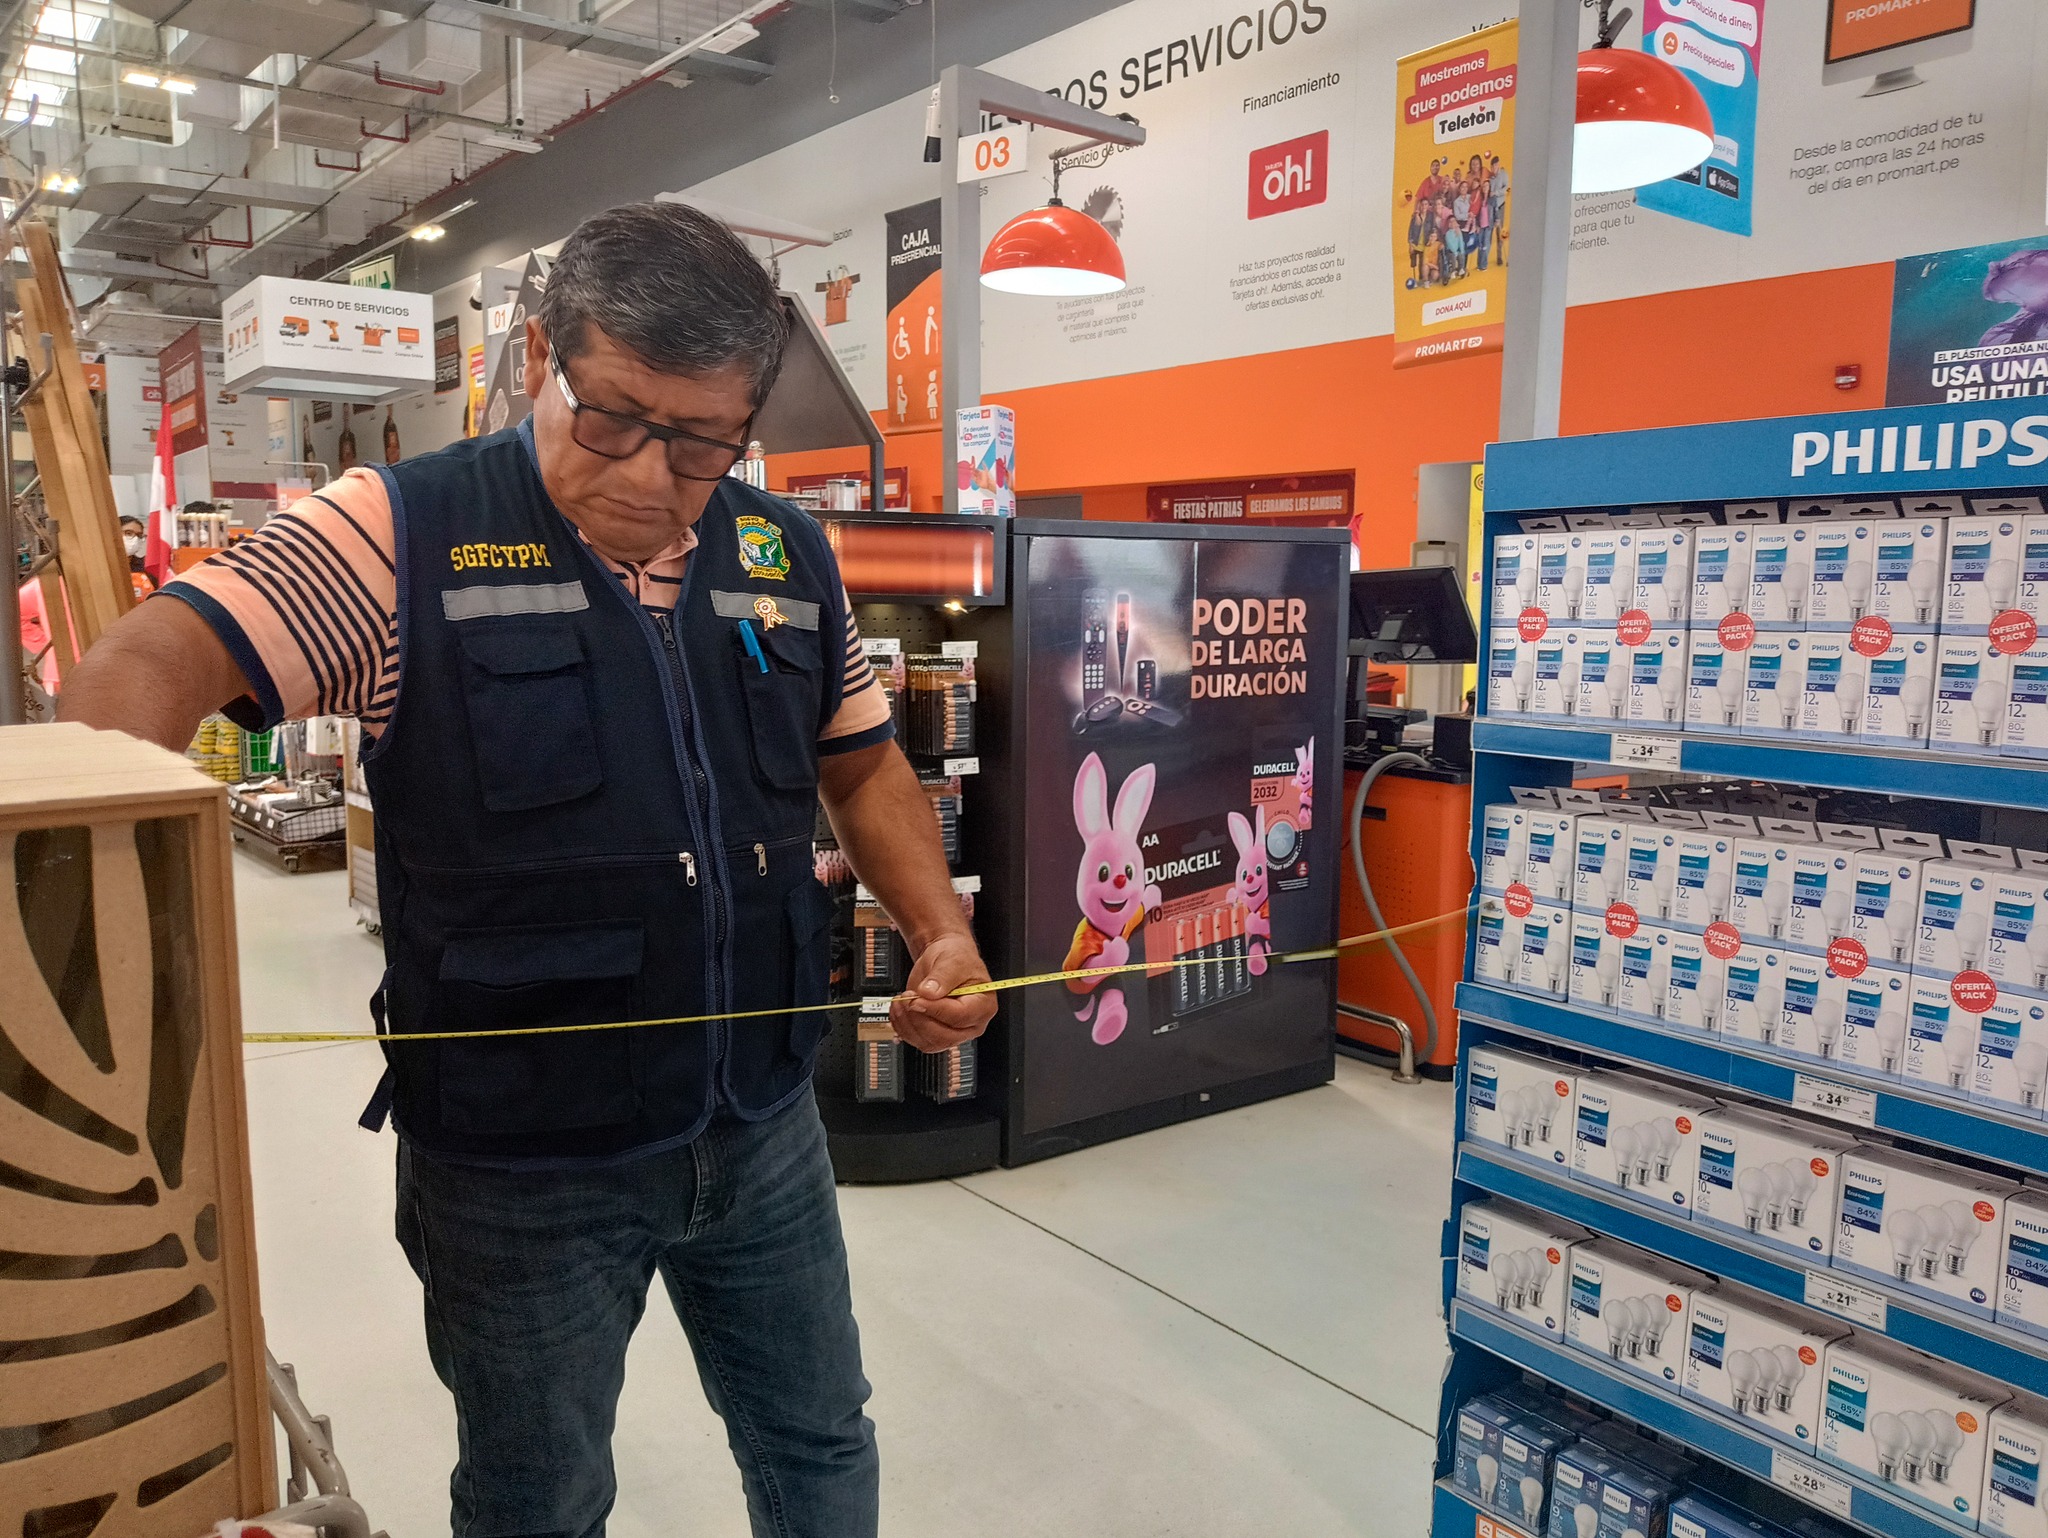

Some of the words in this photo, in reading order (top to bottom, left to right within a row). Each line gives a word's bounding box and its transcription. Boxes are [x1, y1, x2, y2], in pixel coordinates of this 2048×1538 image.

[1718, 13, 1728, 23] de
[1729, 16, 1753, 31] dinero
[1119, 0, 1328, 99] SERVICIOS
[1683, 41, 1703, 60] Precios
[1703, 53, 1735, 71] especiales
[1420, 57, 1485, 87] Mostremos
[1243, 72, 1340, 113] Financiamiento
[1410, 97, 1437, 118] que
[1440, 74, 1513, 111] podemos
[1793, 142, 1837, 161] Desde
[1840, 139, 1852, 152] la
[1855, 120, 1938, 149] comodidad
[1943, 115, 1963, 131] de
[1968, 112, 1983, 125] tu
[975, 136, 1010, 171] 03
[1061, 149, 1099, 171] Servicio
[1790, 163, 1830, 181] hogar,
[1834, 150, 1888, 172] compra
[1893, 146, 1913, 161] las
[1917, 140, 1936, 156] 24
[1942, 131, 1984, 150] horas
[1263, 149, 1312, 201] oh!
[1265, 162, 1283, 172] TARJETA
[1808, 180, 1828, 195] del
[1831, 176, 1852, 191] día
[1856, 175, 1873, 187] en
[1877, 156, 1960, 183] promart.pe
[1574, 200, 1630, 218] ofrecemos
[1574, 222, 1597, 236] para
[1600, 218, 1621, 231] que
[1624, 214, 1635, 225] tu
[902, 228, 929, 250] CAJA
[891, 244, 943, 267] PREFERENCIAL
[1239, 263, 1252, 273] Haz
[1254, 261, 1265, 270] tus
[1267, 252, 1303, 269] proyectos
[1305, 244, 1336, 259] realidad
[1281, 269, 1291, 278] en
[1292, 263, 1318, 276] cuotas
[1320, 260, 1335, 270] con
[1337, 258, 1345, 266] tu
[1232, 289, 1254, 301] Tarjeta
[1271, 280, 1304, 293] Además,
[1306, 273, 1334, 287] accede
[289, 295, 334, 309] CENTRO
[337, 300, 351, 311] DE
[354, 302, 409, 317] SERVICIOS
[1245, 299, 1270, 311] ofertas
[1271, 293, 1308, 308] exclusivas
[1435, 304, 1454, 316] DONA
[1454, 298, 1472, 312] AQUÍ
[494, 309, 506, 328] 01
[1415, 339, 1468, 358] PROMART
[1937, 352, 1949, 362] EL
[1950, 346, 2001, 360] PLÁSTICO
[2002, 342, 2034, 356] DAÑA
[89, 373, 101, 388] 2
[1932, 363, 1989, 388] USA
[1991, 358, 2048, 383] UNA
[1790, 415, 2048, 477] PHILIPS
[1173, 502, 1207, 520] FIESTAS
[1208, 501, 1243, 519] PATRIAS
[1250, 497, 1294, 513] CELEBRAMOS
[1296, 497, 1308, 511] LOS
[1310, 495, 1343, 512] CAMBIOS
[1956, 530, 1989, 538] PHILIPS
[450, 543, 552, 572] SGFCYPM
[1192, 598, 1307, 636] PODER
[1520, 616, 1545, 624] OFERTA
[1623, 626, 1643, 634] PACK
[1721, 624, 1752, 634] OFERTA
[1725, 632, 1747, 640] PACK
[1856, 626, 1888, 638] OFERTA
[1993, 622, 2031, 635] OFERTA
[2000, 631, 2027, 643] PACK
[1811, 644, 1840, 652] PHILIPS
[1859, 635, 1882, 645] PACK
[1191, 640, 1222, 667] DE
[1228, 638, 1307, 665] LARGA
[1945, 649, 1977, 657] PHILIPS
[1191, 664, 1307, 699] DURACIÓN
[1254, 762, 1297, 775] DURACELL
[1254, 786, 1277, 799] 2032
[1142, 834, 1160, 848] AA
[1144, 850, 1222, 885] DURACELL
[1860, 867, 1889, 877] PHILIPS
[1930, 877, 1961, 888] PHILIPS
[1506, 891, 1533, 903] OFERTA
[1999, 887, 2033, 899] PHILIPS
[1509, 900, 1527, 909] PACK
[1149, 906, 1162, 924] 10
[1608, 912, 1635, 923] OFERTA
[1612, 920, 1631, 929] PACK
[1708, 929, 1738, 945] OFERTA
[1710, 938, 1732, 951] PACK
[1831, 947, 1864, 962] OFERTA
[1834, 957, 1858, 968] PACK
[1917, 989, 1948, 1000] PHILIPS
[1955, 982, 1991, 991] OFERTA
[1961, 991, 1987, 1000] PACK
[1826, 1093, 1842, 1106] 34
[1704, 1132, 1733, 1146] PHILIPS
[1849, 1170, 1882, 1186] PHILIPS
[1836, 1292, 1850, 1306] 21
[1696, 1310, 1724, 1327] PHILIPS
[1832, 1366, 1866, 1385] PHILIPS
[1998, 1435, 2037, 1456] PHILIPS
[1803, 1475, 1818, 1490] 28
